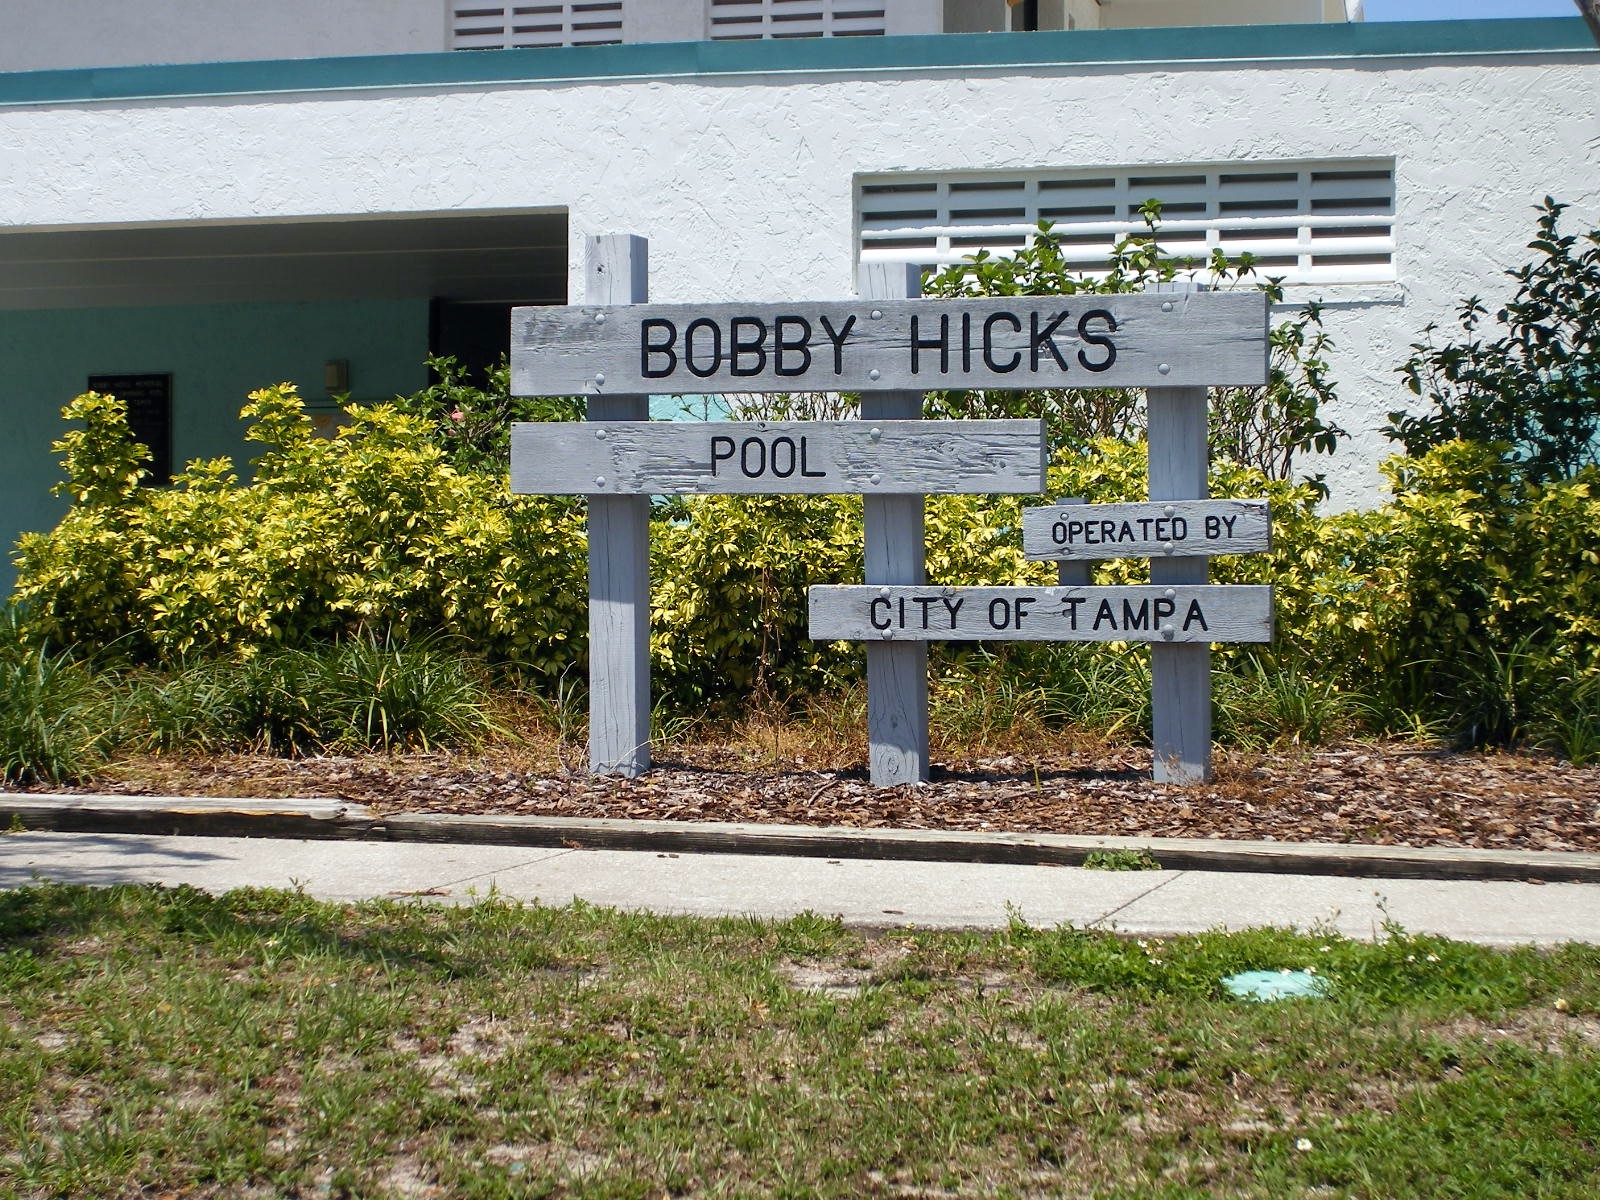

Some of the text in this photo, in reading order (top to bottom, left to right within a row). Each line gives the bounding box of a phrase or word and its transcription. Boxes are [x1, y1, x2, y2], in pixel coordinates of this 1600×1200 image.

[641, 309, 1118, 378] BOBBY HICKS
[711, 436, 826, 478] POOL
[1052, 515, 1237, 544] OPERATED BY
[870, 597, 1209, 632] CITY OF TAMPA
